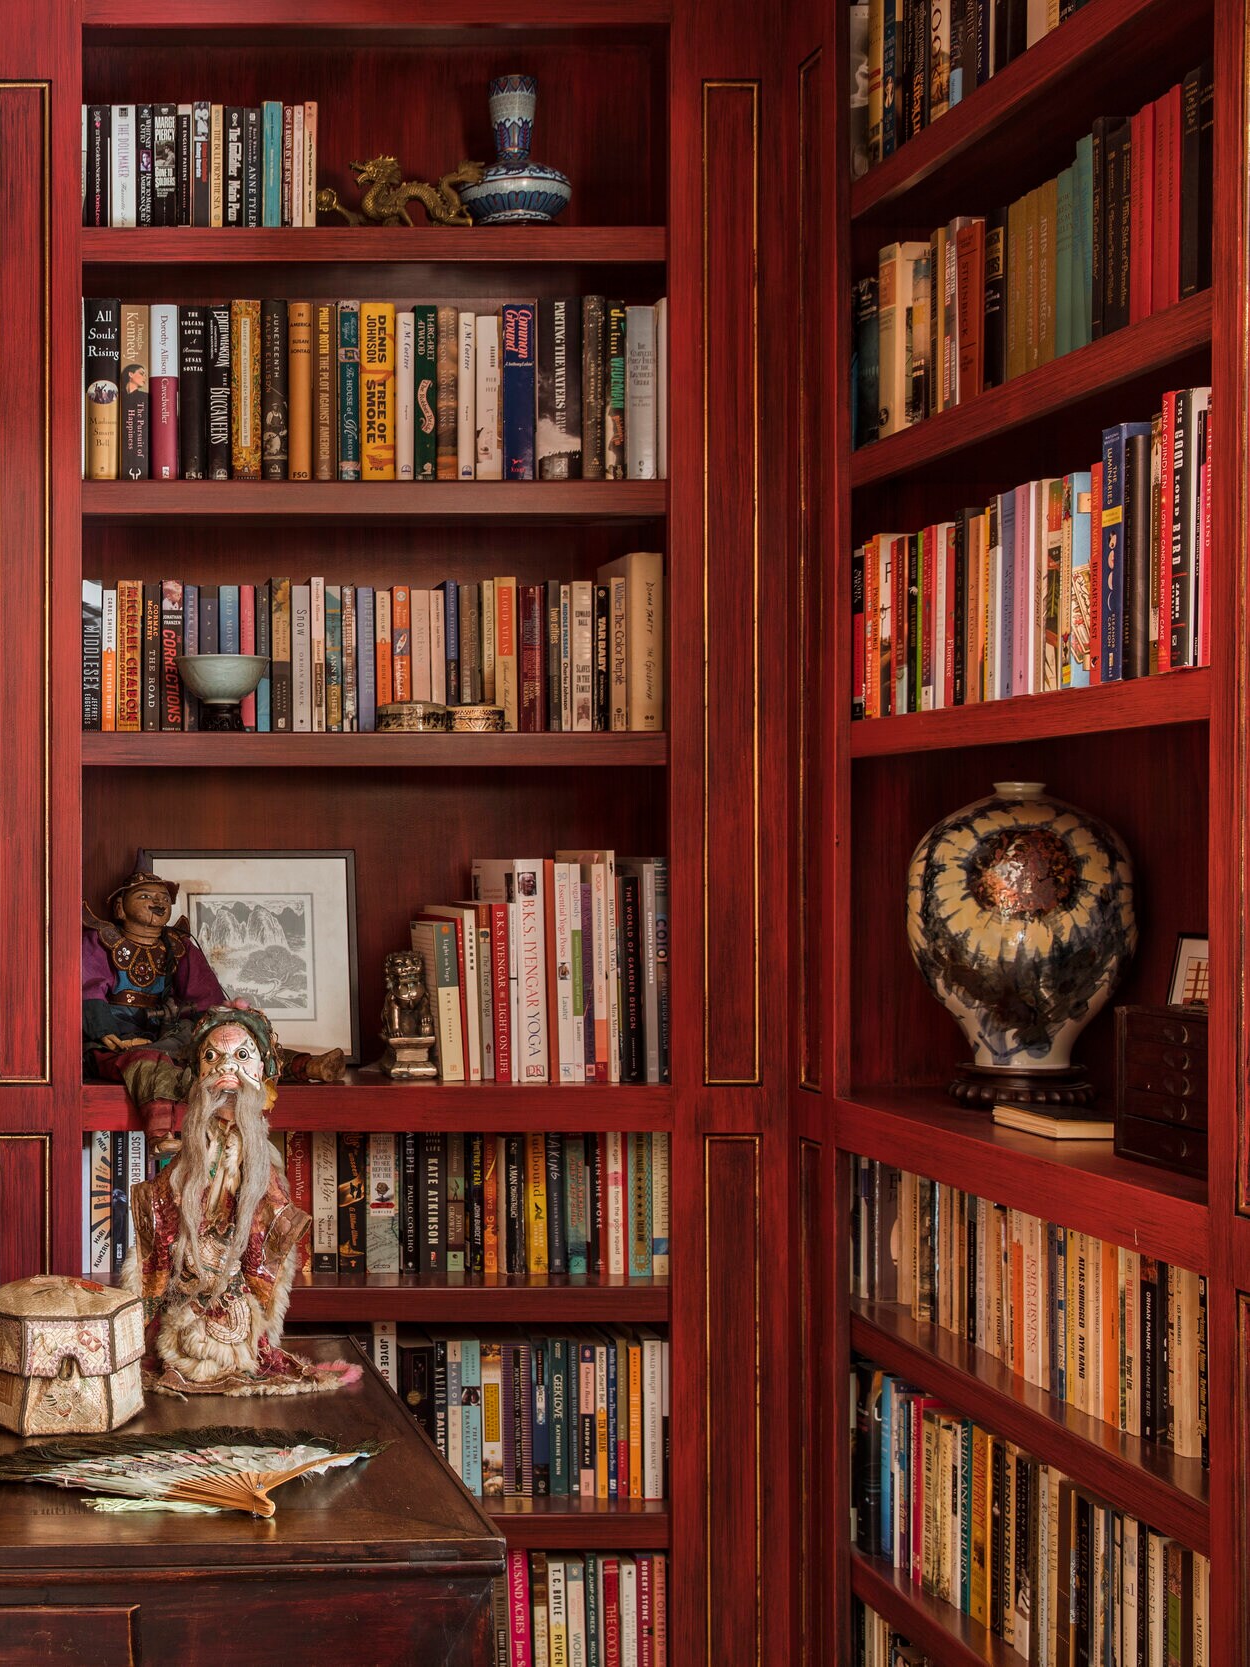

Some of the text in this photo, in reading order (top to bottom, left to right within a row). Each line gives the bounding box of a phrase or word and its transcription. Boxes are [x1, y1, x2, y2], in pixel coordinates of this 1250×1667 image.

[229, 128, 240, 141] The
[228, 180, 240, 201] Mario
[228, 202, 239, 221] Puzo
[95, 311, 112, 322] All
[160, 316, 168, 346] Dorothy
[506, 309, 518, 351] Ground
[123, 312, 138, 361] Kennedy
[136, 324, 144, 350] Douglas
[367, 315, 376, 363] JOHNSON
[378, 315, 386, 363] DENIS
[518, 309, 532, 358] Common
[87, 346, 119, 360] Rising
[367, 380, 375, 443] SMOKE
[378, 380, 386, 443] TREE OF
[126, 410, 135, 450] Happiness
[137, 449, 144, 457] of
[1172, 429, 1184, 565] GOOD LORD BIRD
[297, 610, 307, 636] Snow
[615, 613, 624, 628] The
[83, 625, 99, 690] MIDDLESEX
[615, 631, 623, 655] Color
[164, 630, 180, 723] CORRECTIONS
[558, 884, 566, 914] Essential
[557, 916, 566, 936] Yoga
[628, 942, 634, 953] OF
[525, 941, 539, 1007] IYENGAR
[528, 1012, 540, 1057] YOGA
[428, 1158, 438, 1244] KATE ATKINSON
[380, 1339, 390, 1367] JOYCE
[554, 1375, 563, 1418] GEEK LOVE
[553, 1590, 562, 1615] BOYLE
